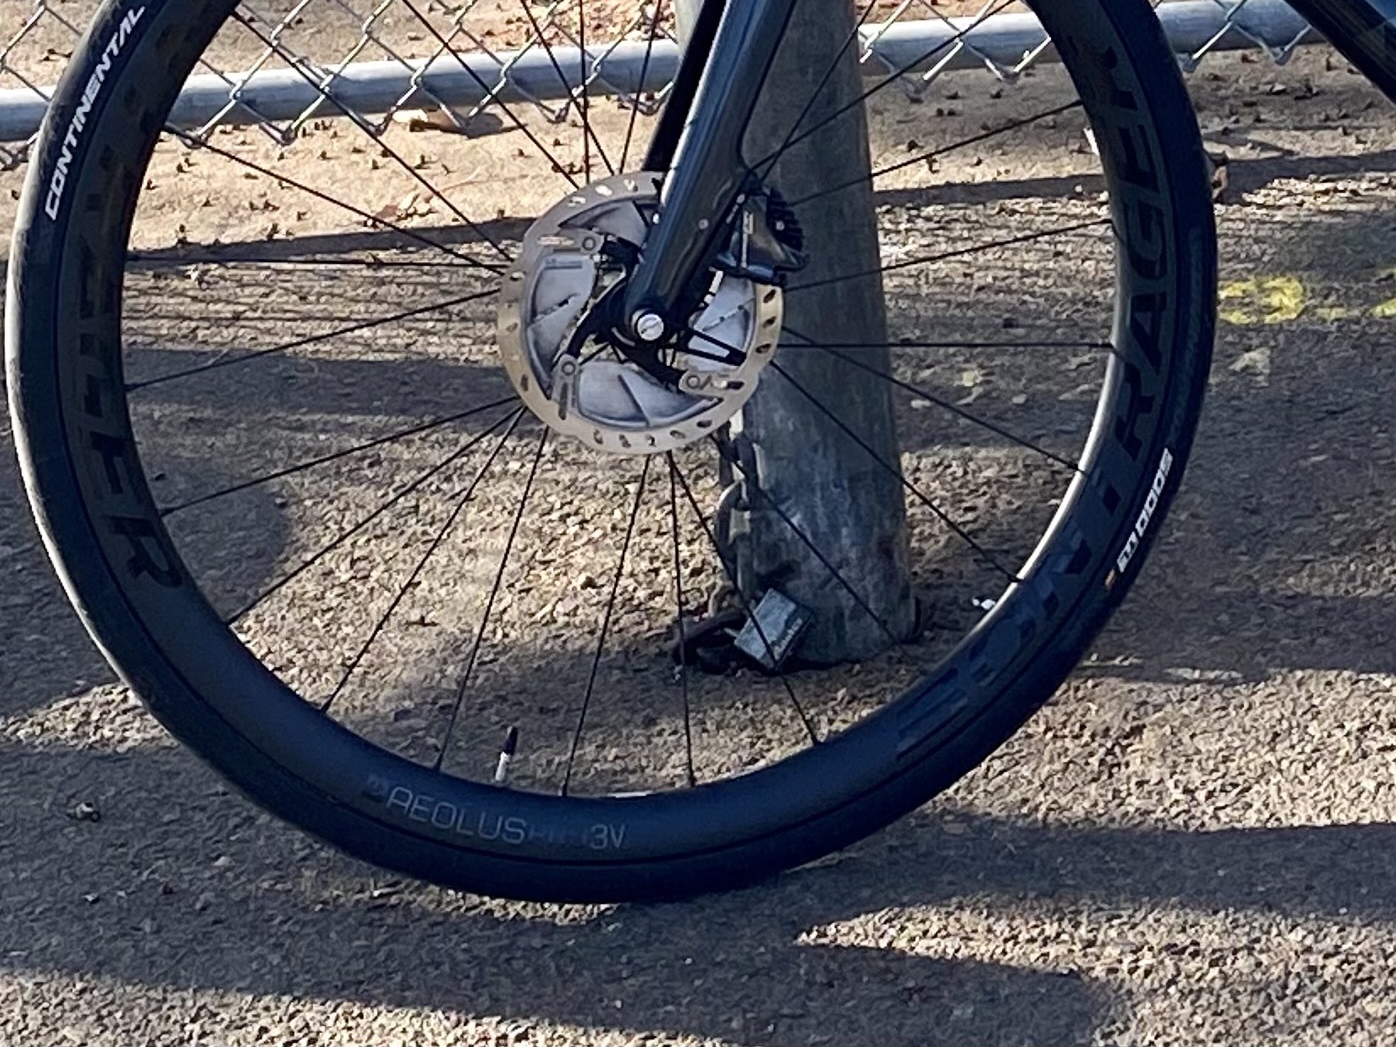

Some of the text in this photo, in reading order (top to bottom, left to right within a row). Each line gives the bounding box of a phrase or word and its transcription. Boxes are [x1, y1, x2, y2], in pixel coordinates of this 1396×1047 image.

[45, 5, 147, 221] CONTINENTAL
[386, 785, 528, 845] AEOLUS
[590, 823, 627, 851] 3V
